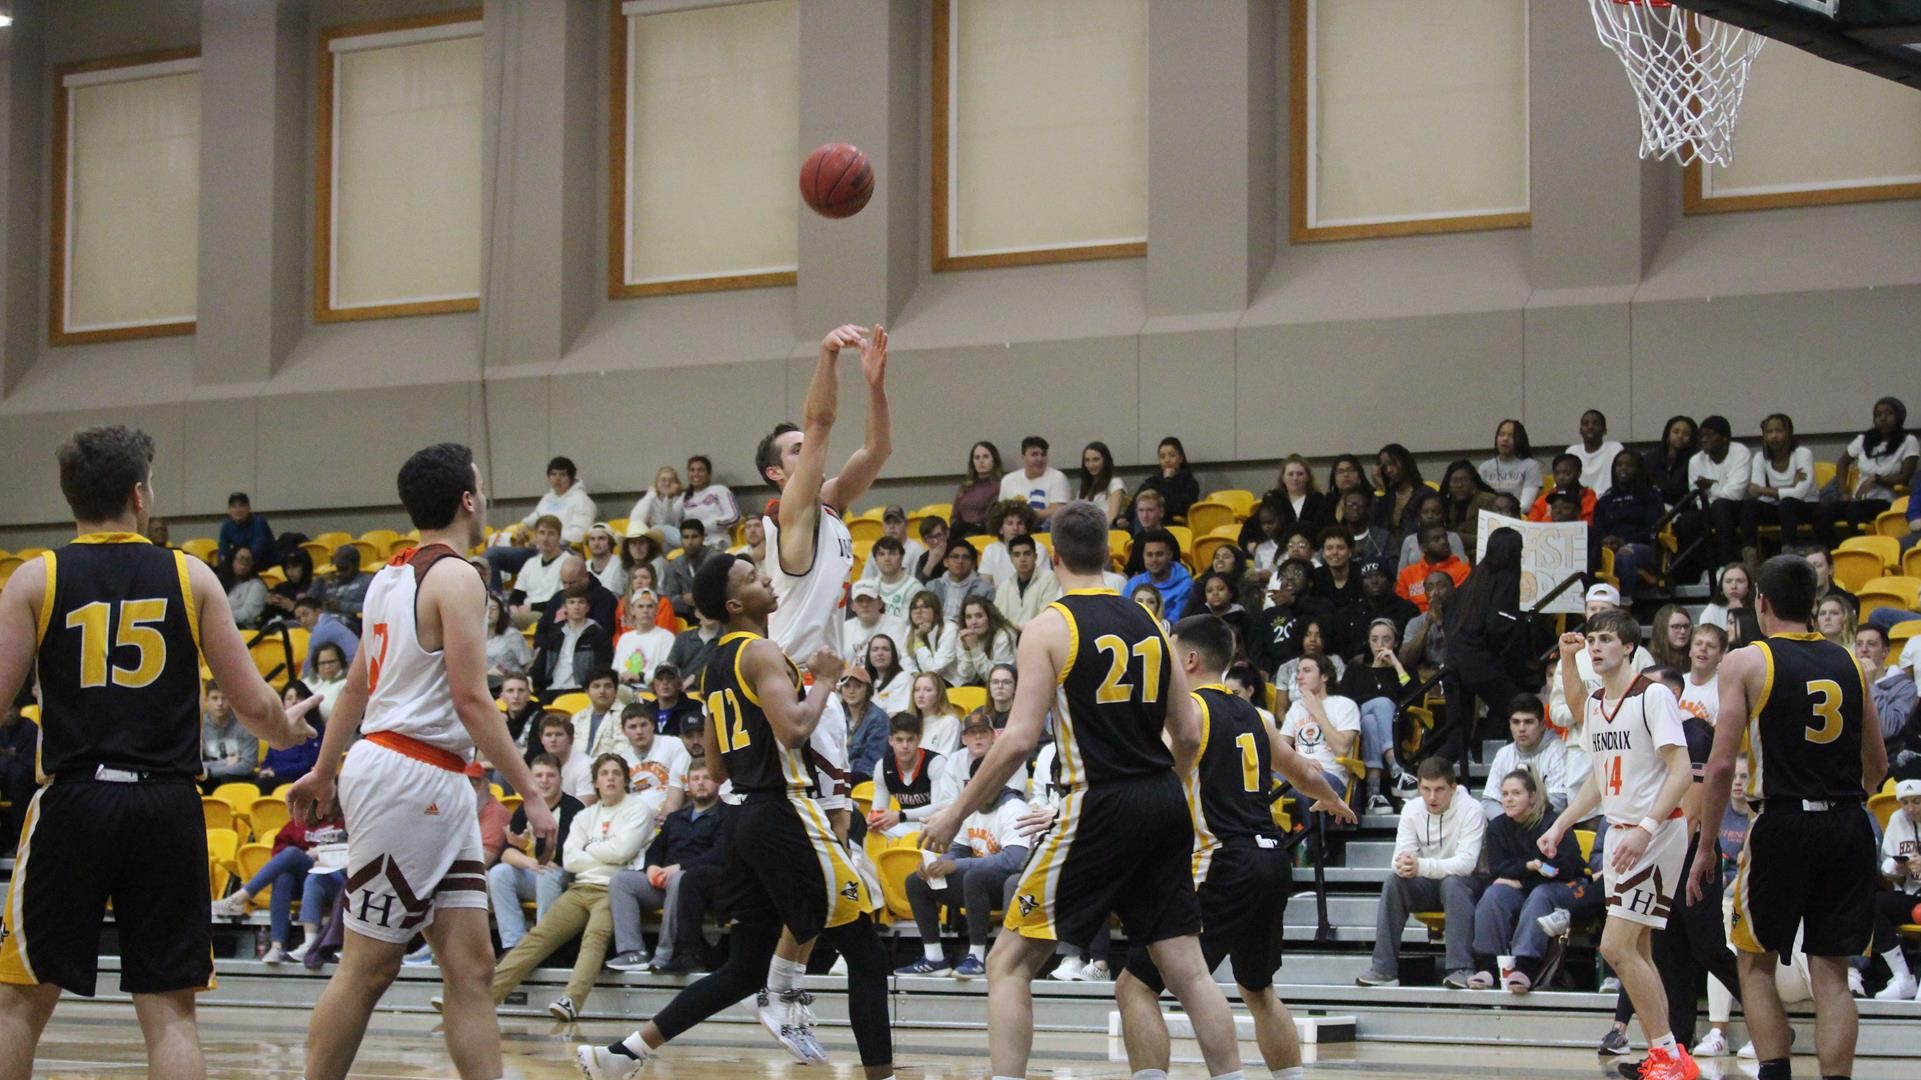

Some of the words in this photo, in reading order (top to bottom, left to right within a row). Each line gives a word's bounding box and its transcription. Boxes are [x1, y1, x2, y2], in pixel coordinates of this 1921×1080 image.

[66, 598, 168, 688] 15
[1094, 634, 1163, 704] 21
[707, 687, 751, 754] 12
[1592, 731, 1632, 752] HENDRIX
[1805, 679, 1844, 744] 3
[1235, 732, 1260, 792] 1
[1604, 755, 1623, 796] 14
[356, 888, 398, 929] H
[1627, 887, 1656, 916] H
